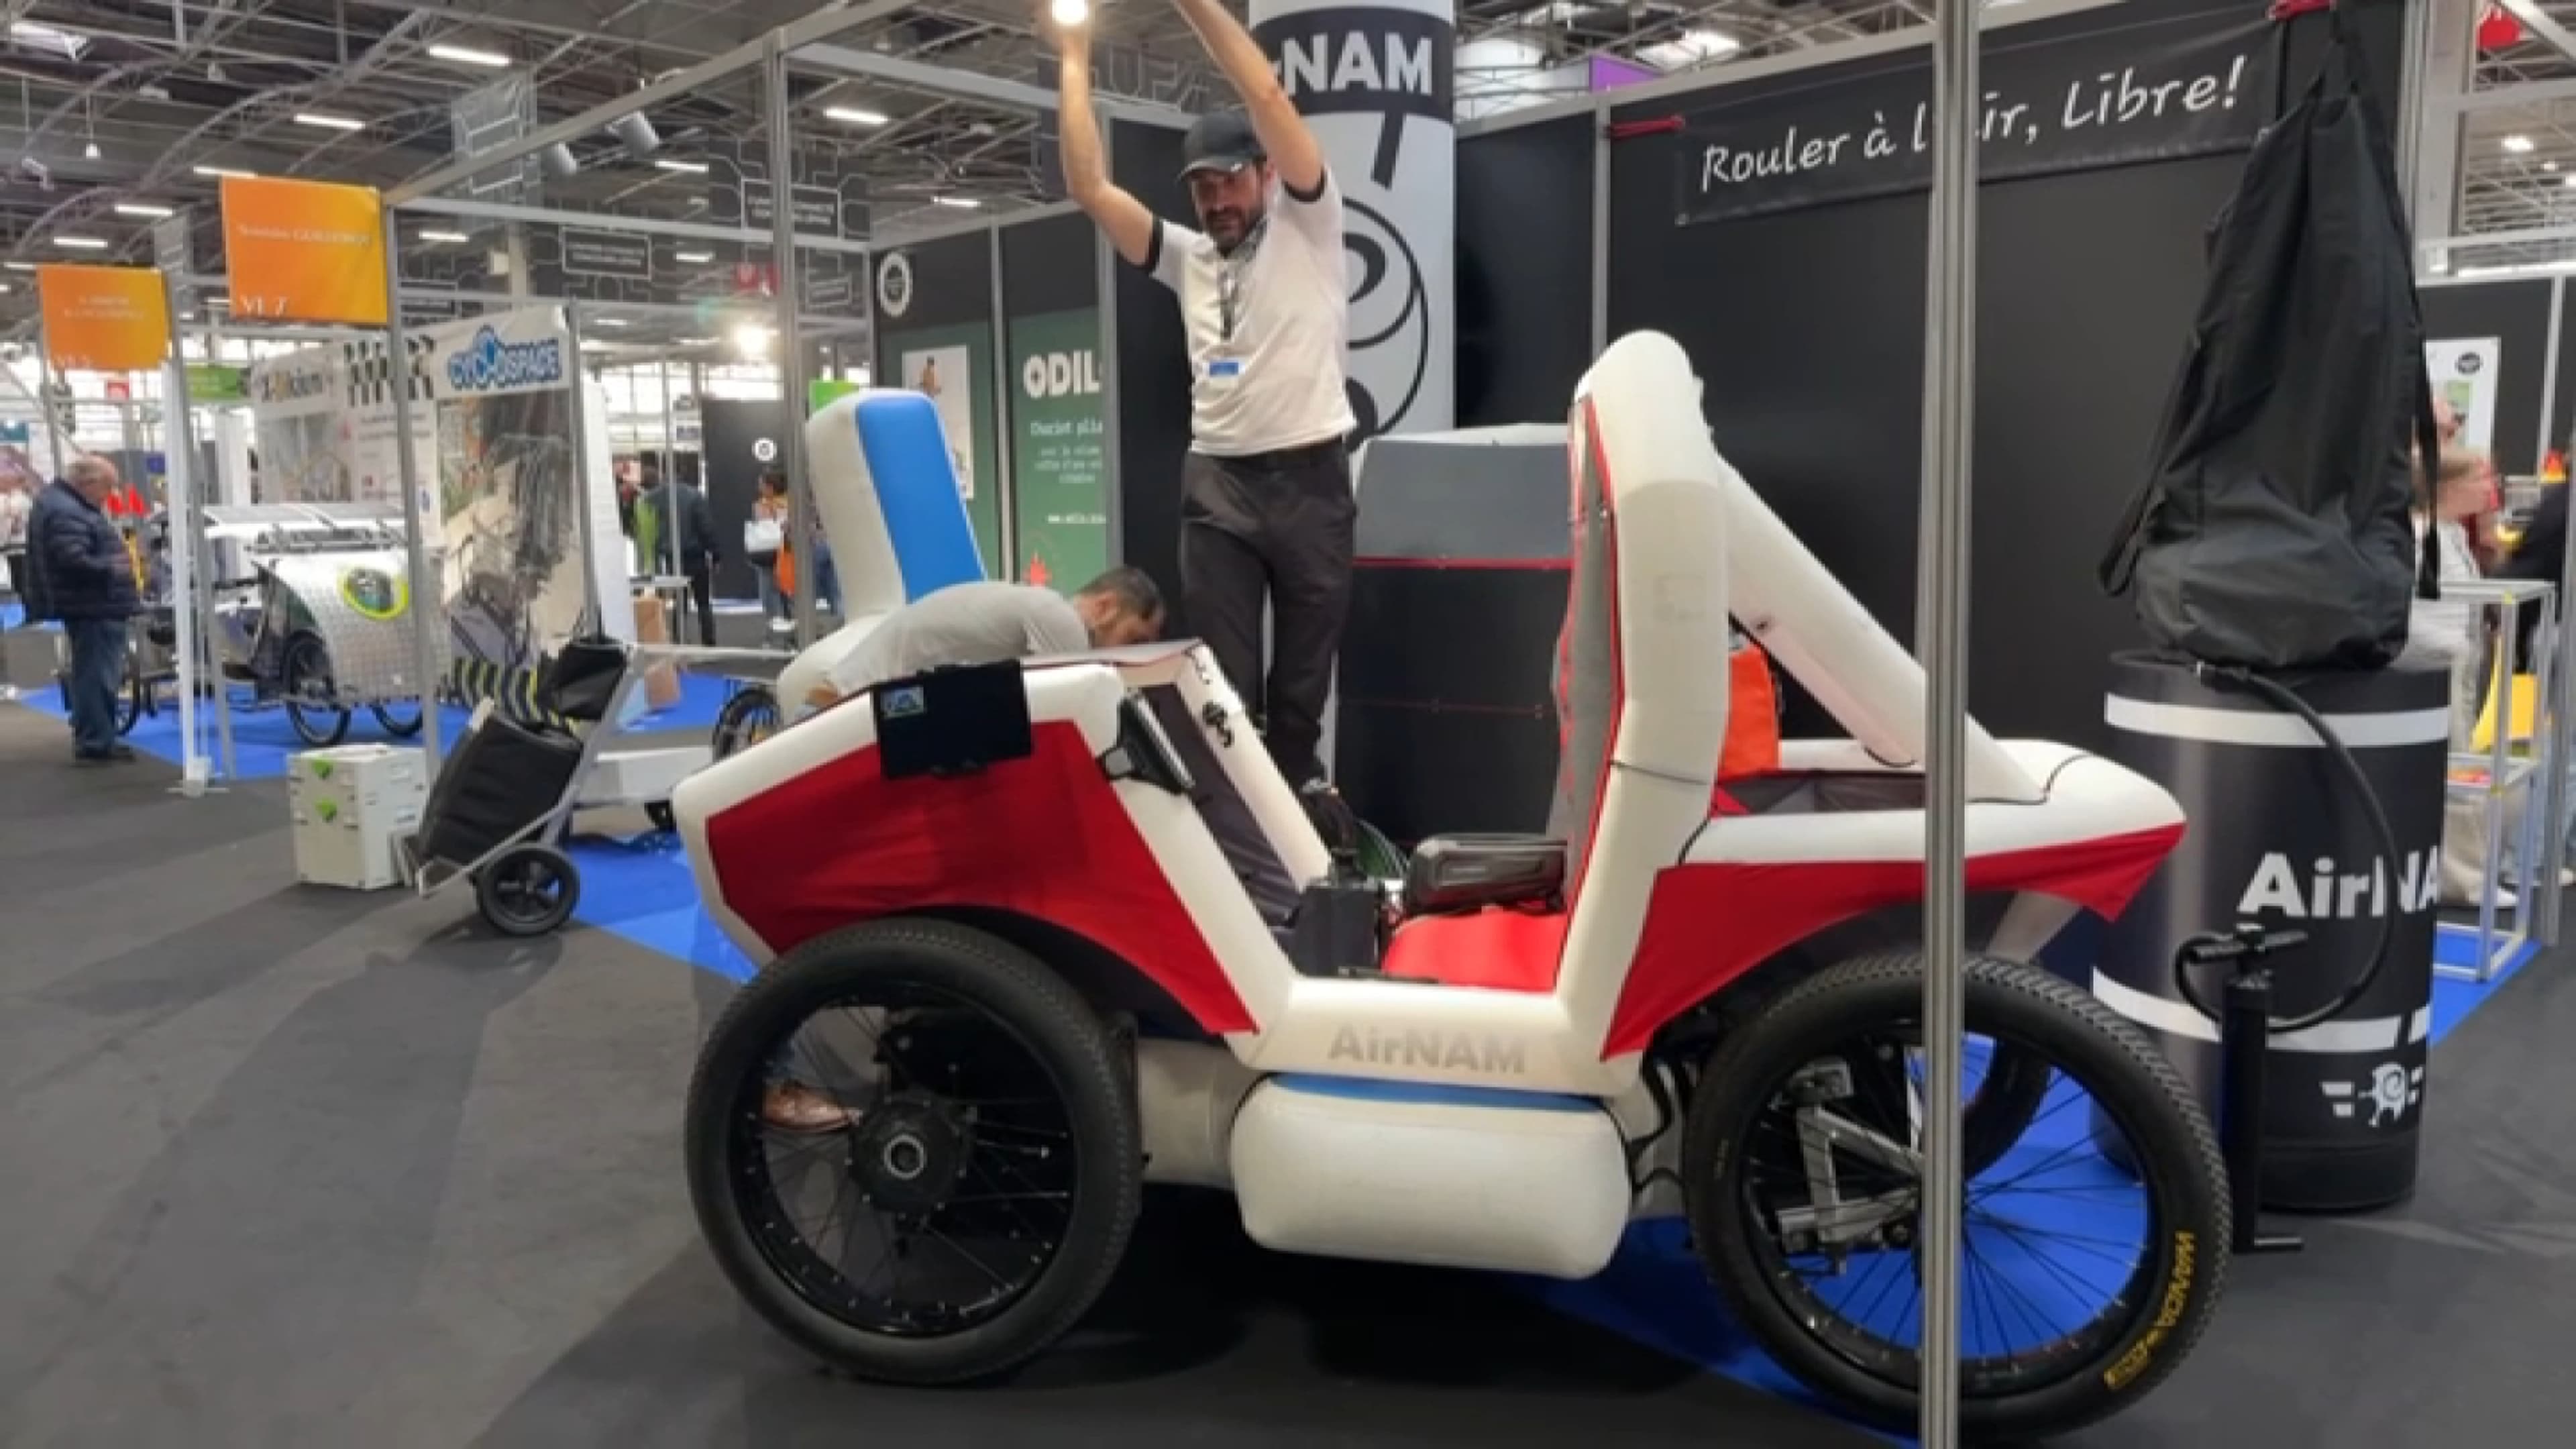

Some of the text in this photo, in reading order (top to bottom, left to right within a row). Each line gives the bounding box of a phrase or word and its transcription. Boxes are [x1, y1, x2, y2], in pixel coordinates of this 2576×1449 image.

[1273, 30, 1434, 96] NAM
[1701, 54, 2247, 193] Rouler à lir, Libre!
[1024, 349, 1103, 398] ODIL
[1327, 1023, 1525, 1075] AirNAM
